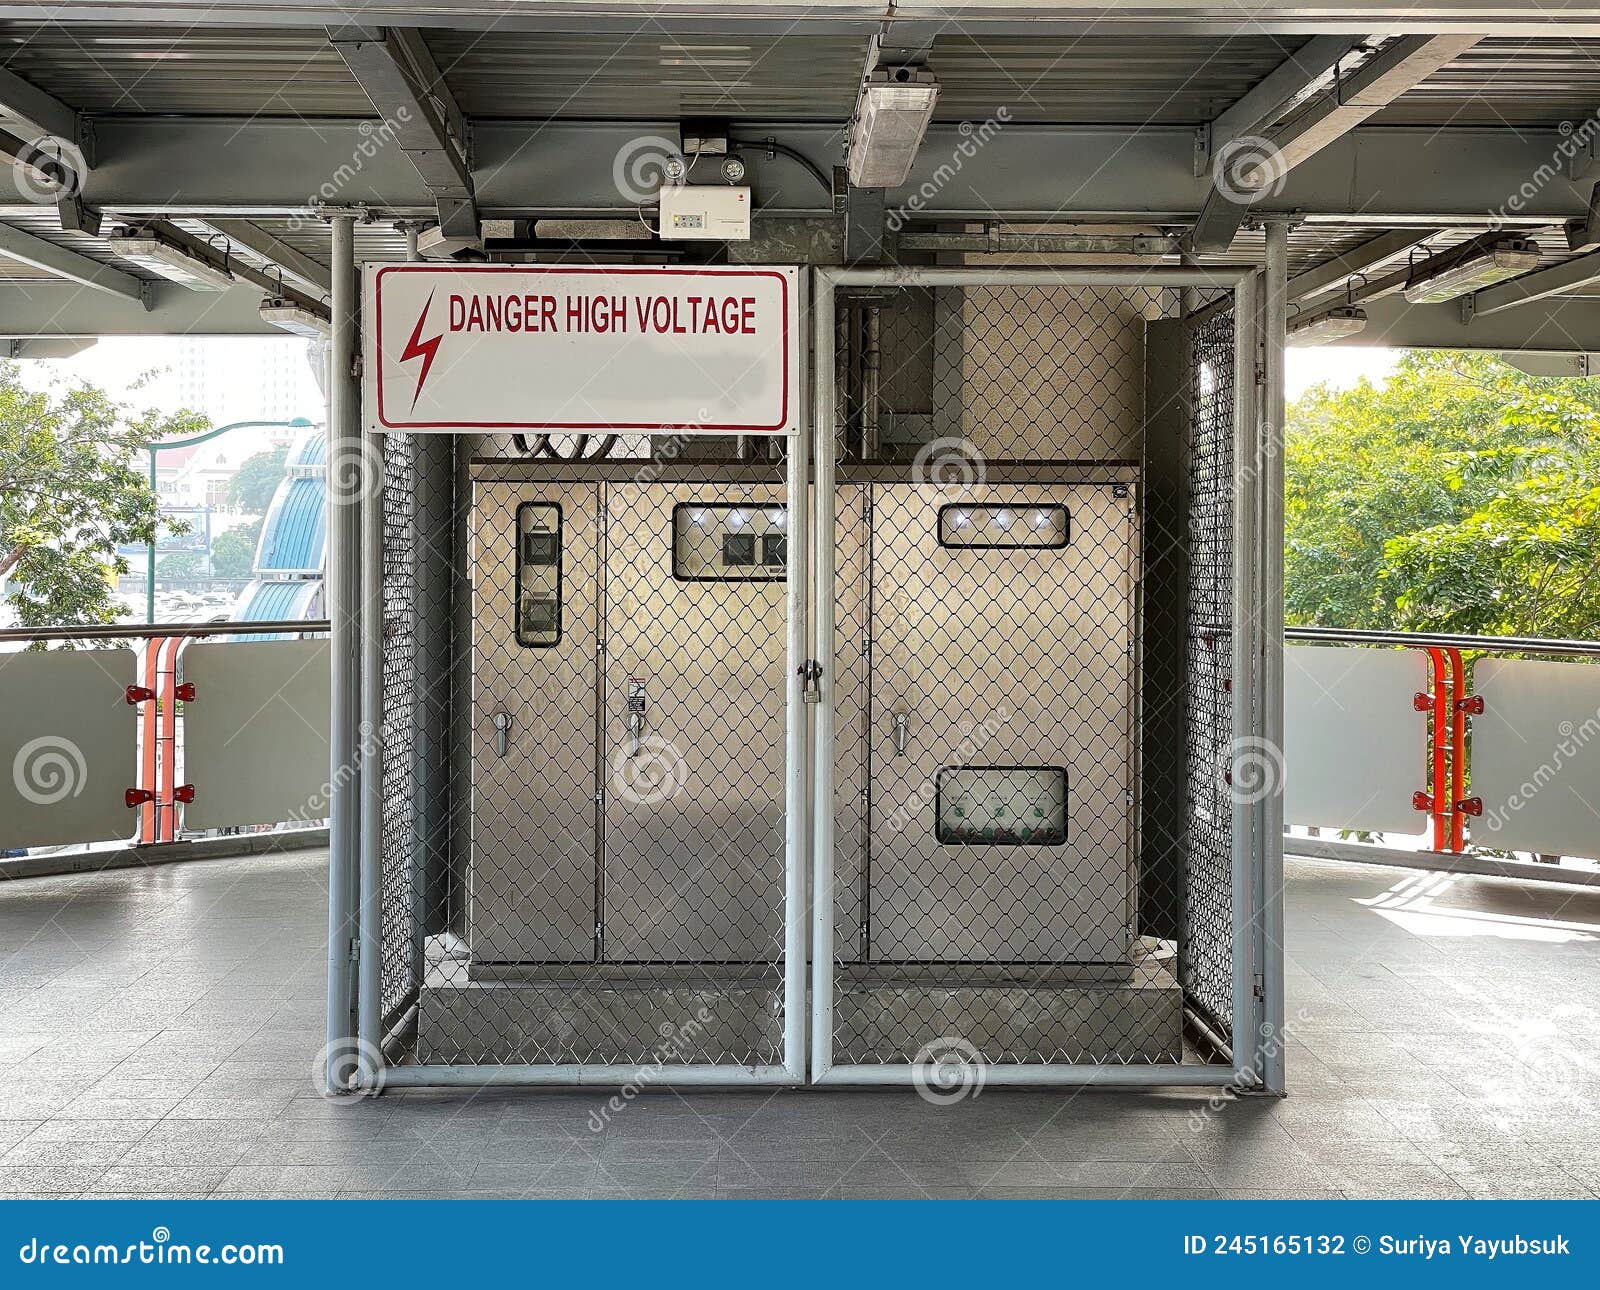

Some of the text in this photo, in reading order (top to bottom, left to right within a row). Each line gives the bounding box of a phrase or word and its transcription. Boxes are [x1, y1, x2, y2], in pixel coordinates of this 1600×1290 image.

[449, 294, 756, 334] DANGER HIGH VOLTAGE
